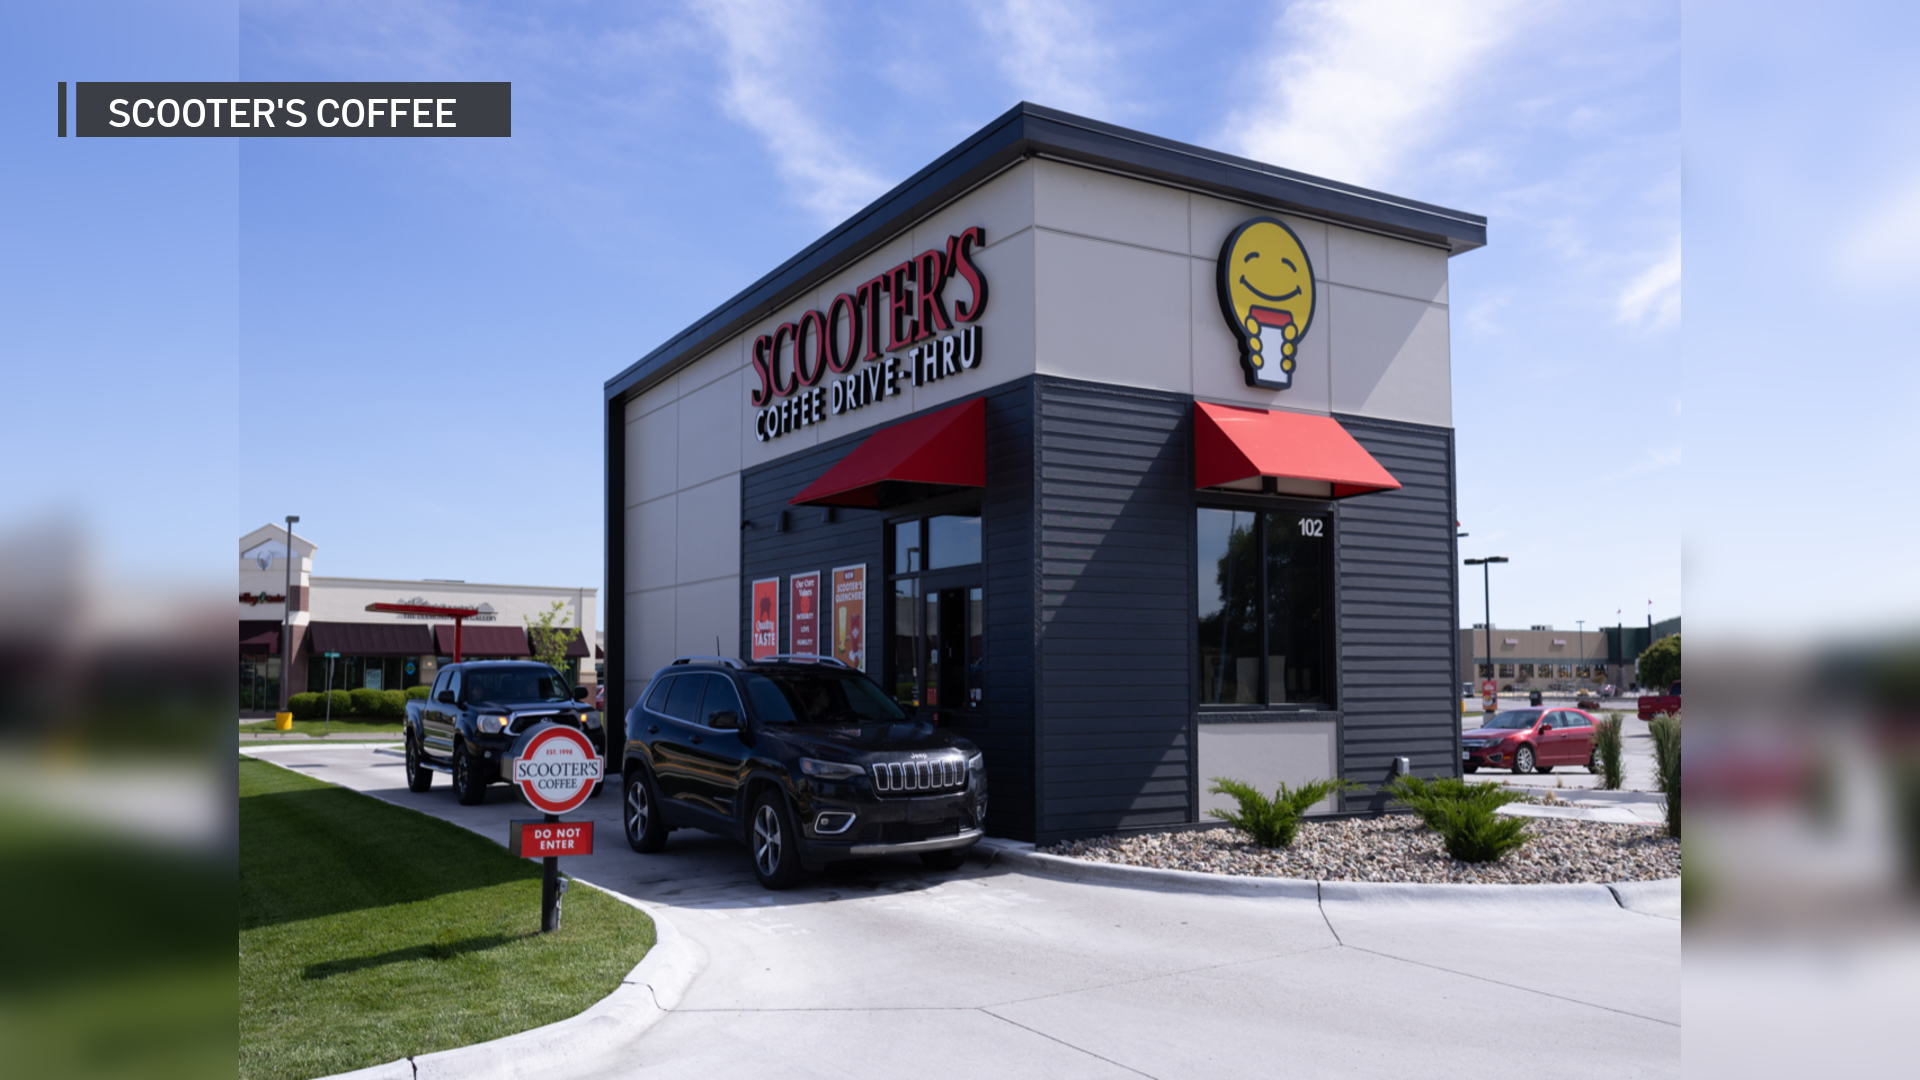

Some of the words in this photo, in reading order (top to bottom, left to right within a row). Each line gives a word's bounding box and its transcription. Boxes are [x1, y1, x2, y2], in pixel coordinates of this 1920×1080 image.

[752, 226, 988, 407] SCOOTER'S
[755, 387, 826, 442] COFFEE
[832, 325, 982, 415] DRIVE-THRU
[1298, 517, 1323, 537] 102
[836, 580, 863, 593] SCOOTER'S
[755, 619, 775, 632] Quality
[754, 632, 775, 647] TASTE
[518, 761, 598, 778] SCOOTER'S
[538, 778, 578, 789] COFFEE
[534, 829, 552, 839] DO
[556, 828, 581, 838] NOT
[540, 839, 574, 850] ENTER
